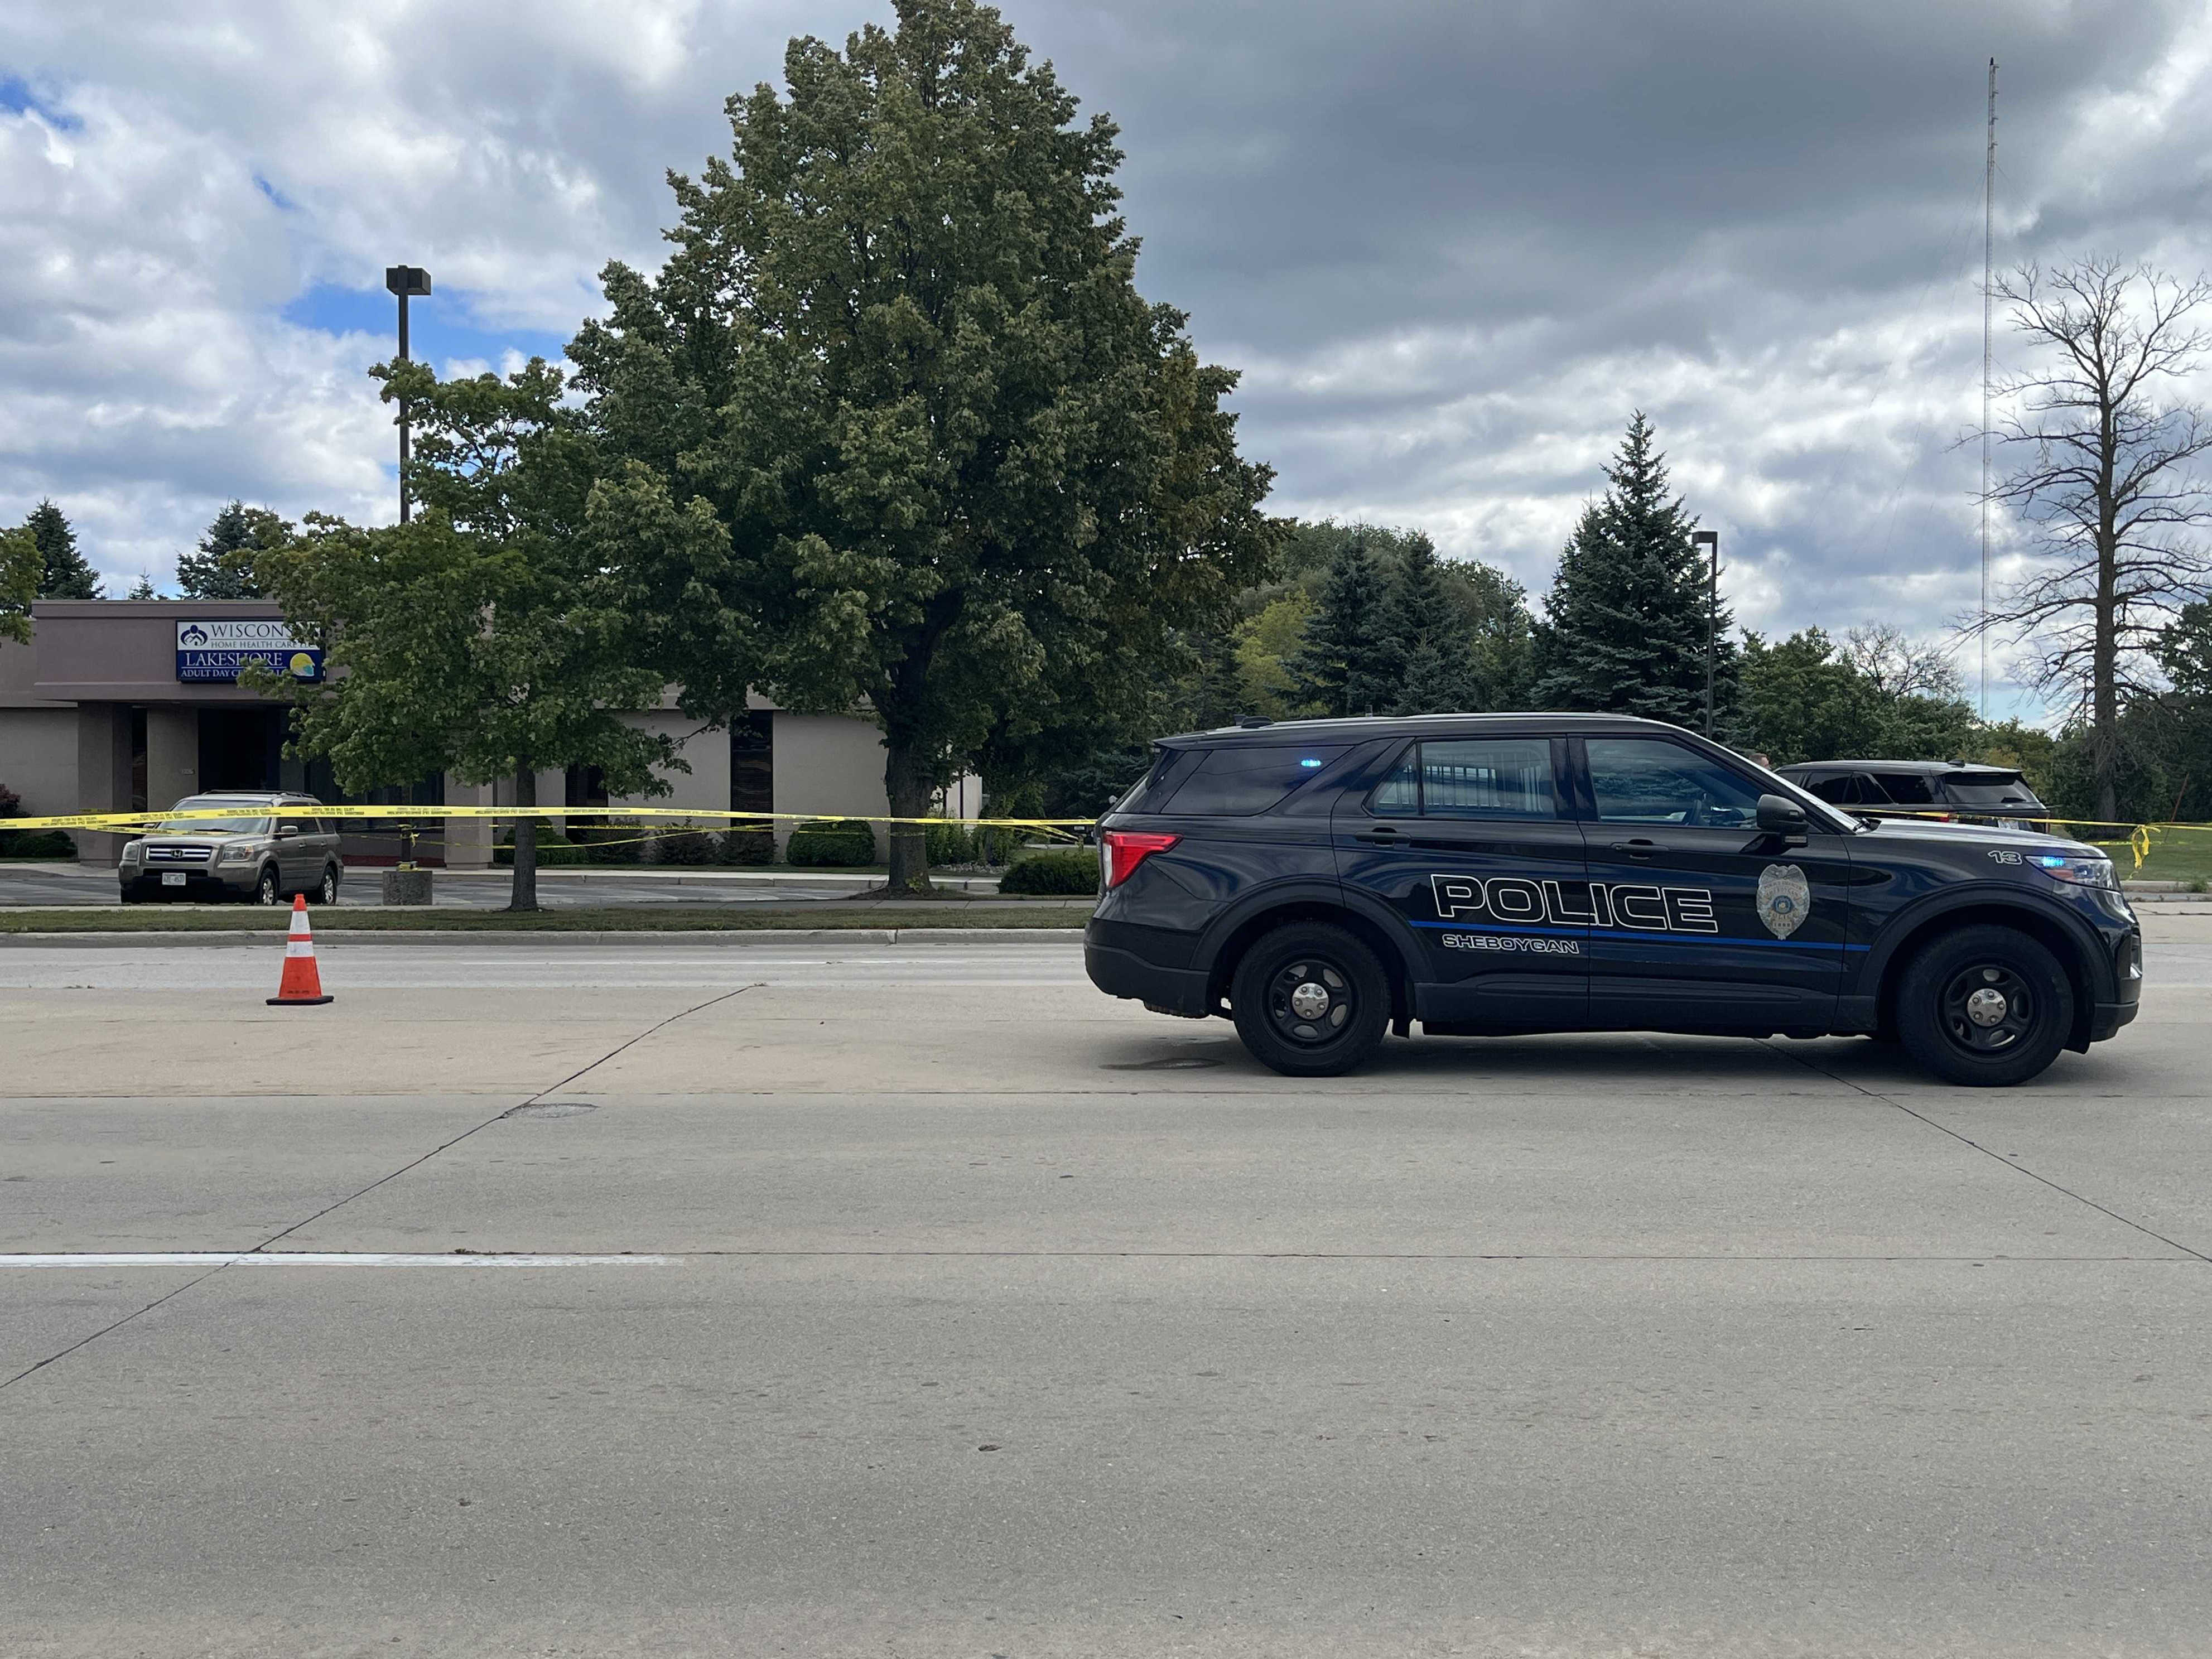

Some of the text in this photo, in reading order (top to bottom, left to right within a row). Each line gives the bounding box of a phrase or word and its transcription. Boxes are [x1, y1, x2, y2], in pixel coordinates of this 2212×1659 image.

[211, 624, 296, 638] WISCONS
[1987, 850, 2022, 865] 13
[1430, 874, 1718, 932] POLICE
[1442, 934, 1579, 954] SHEBOYGAN
